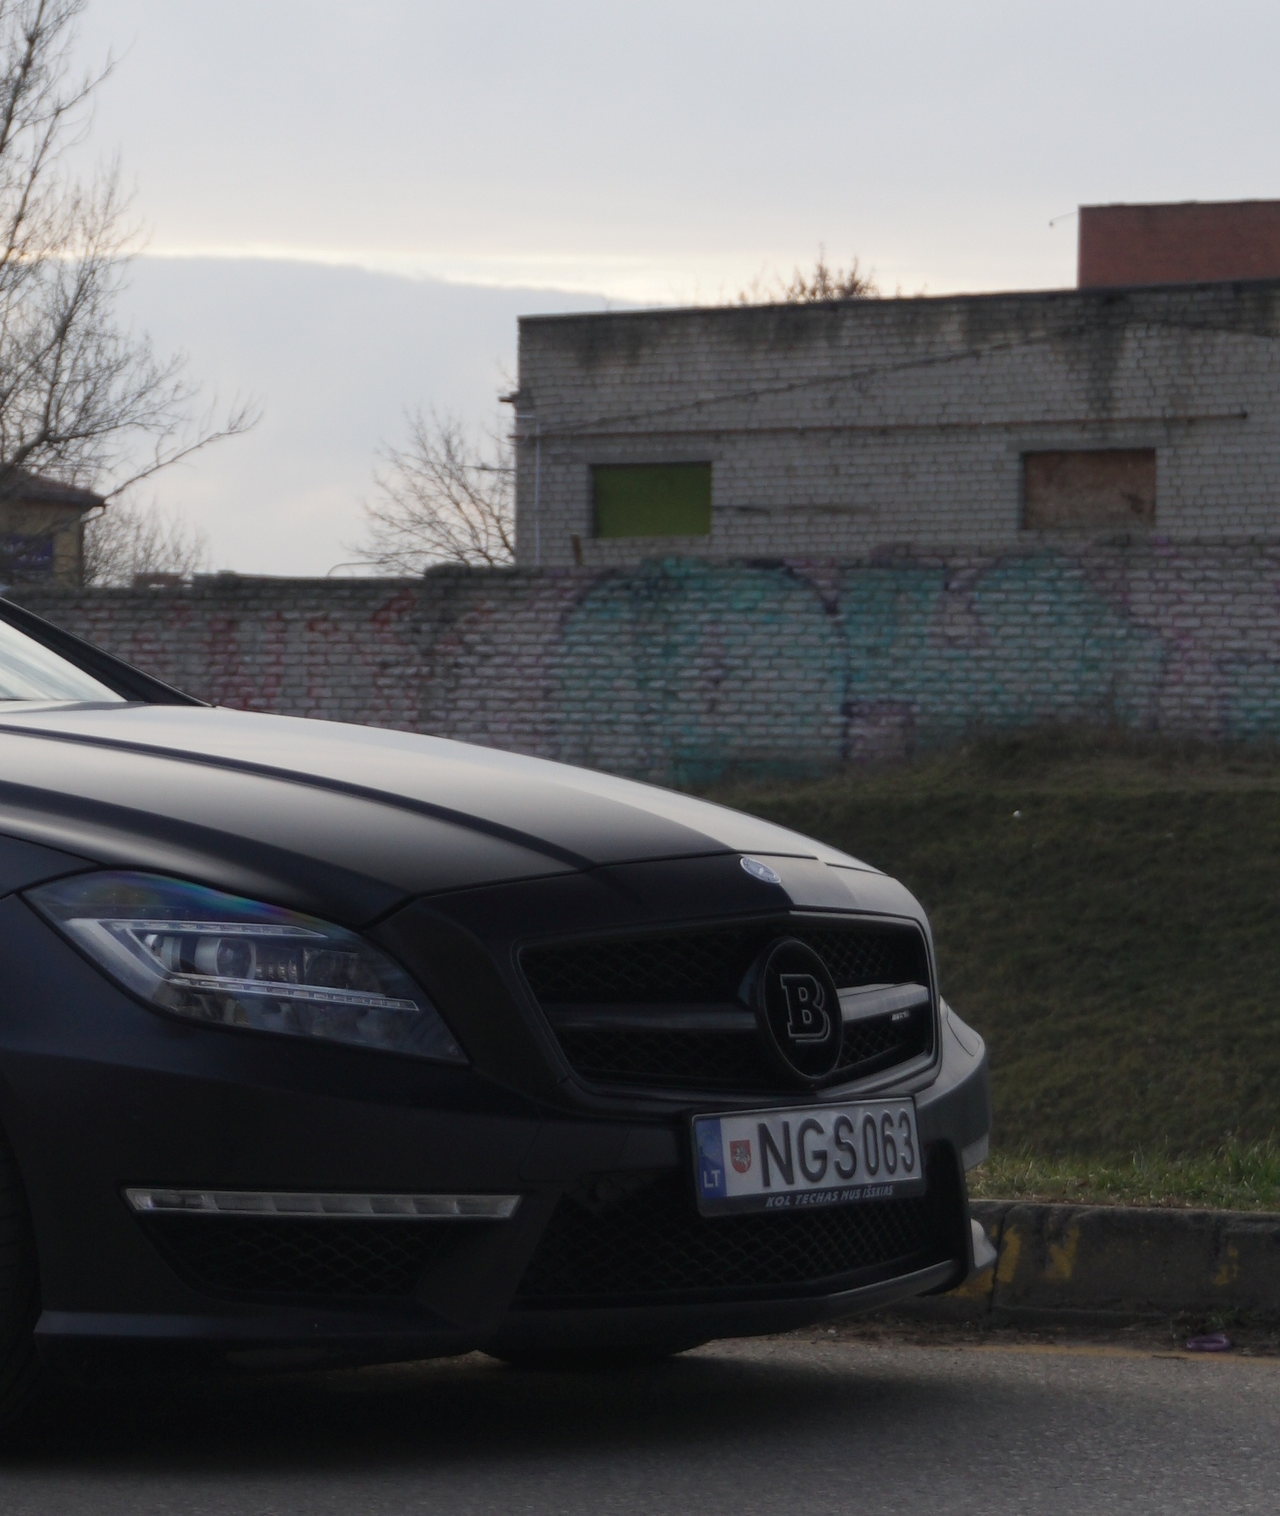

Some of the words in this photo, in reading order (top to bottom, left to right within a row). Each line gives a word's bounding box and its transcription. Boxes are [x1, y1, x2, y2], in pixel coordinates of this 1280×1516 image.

[780, 973, 830, 1042] B
[703, 1169, 721, 1188] LT
[765, 1195, 791, 1208] KOL
[794, 1191, 839, 1205] TECHAS
[840, 1189, 861, 1201] MUS
